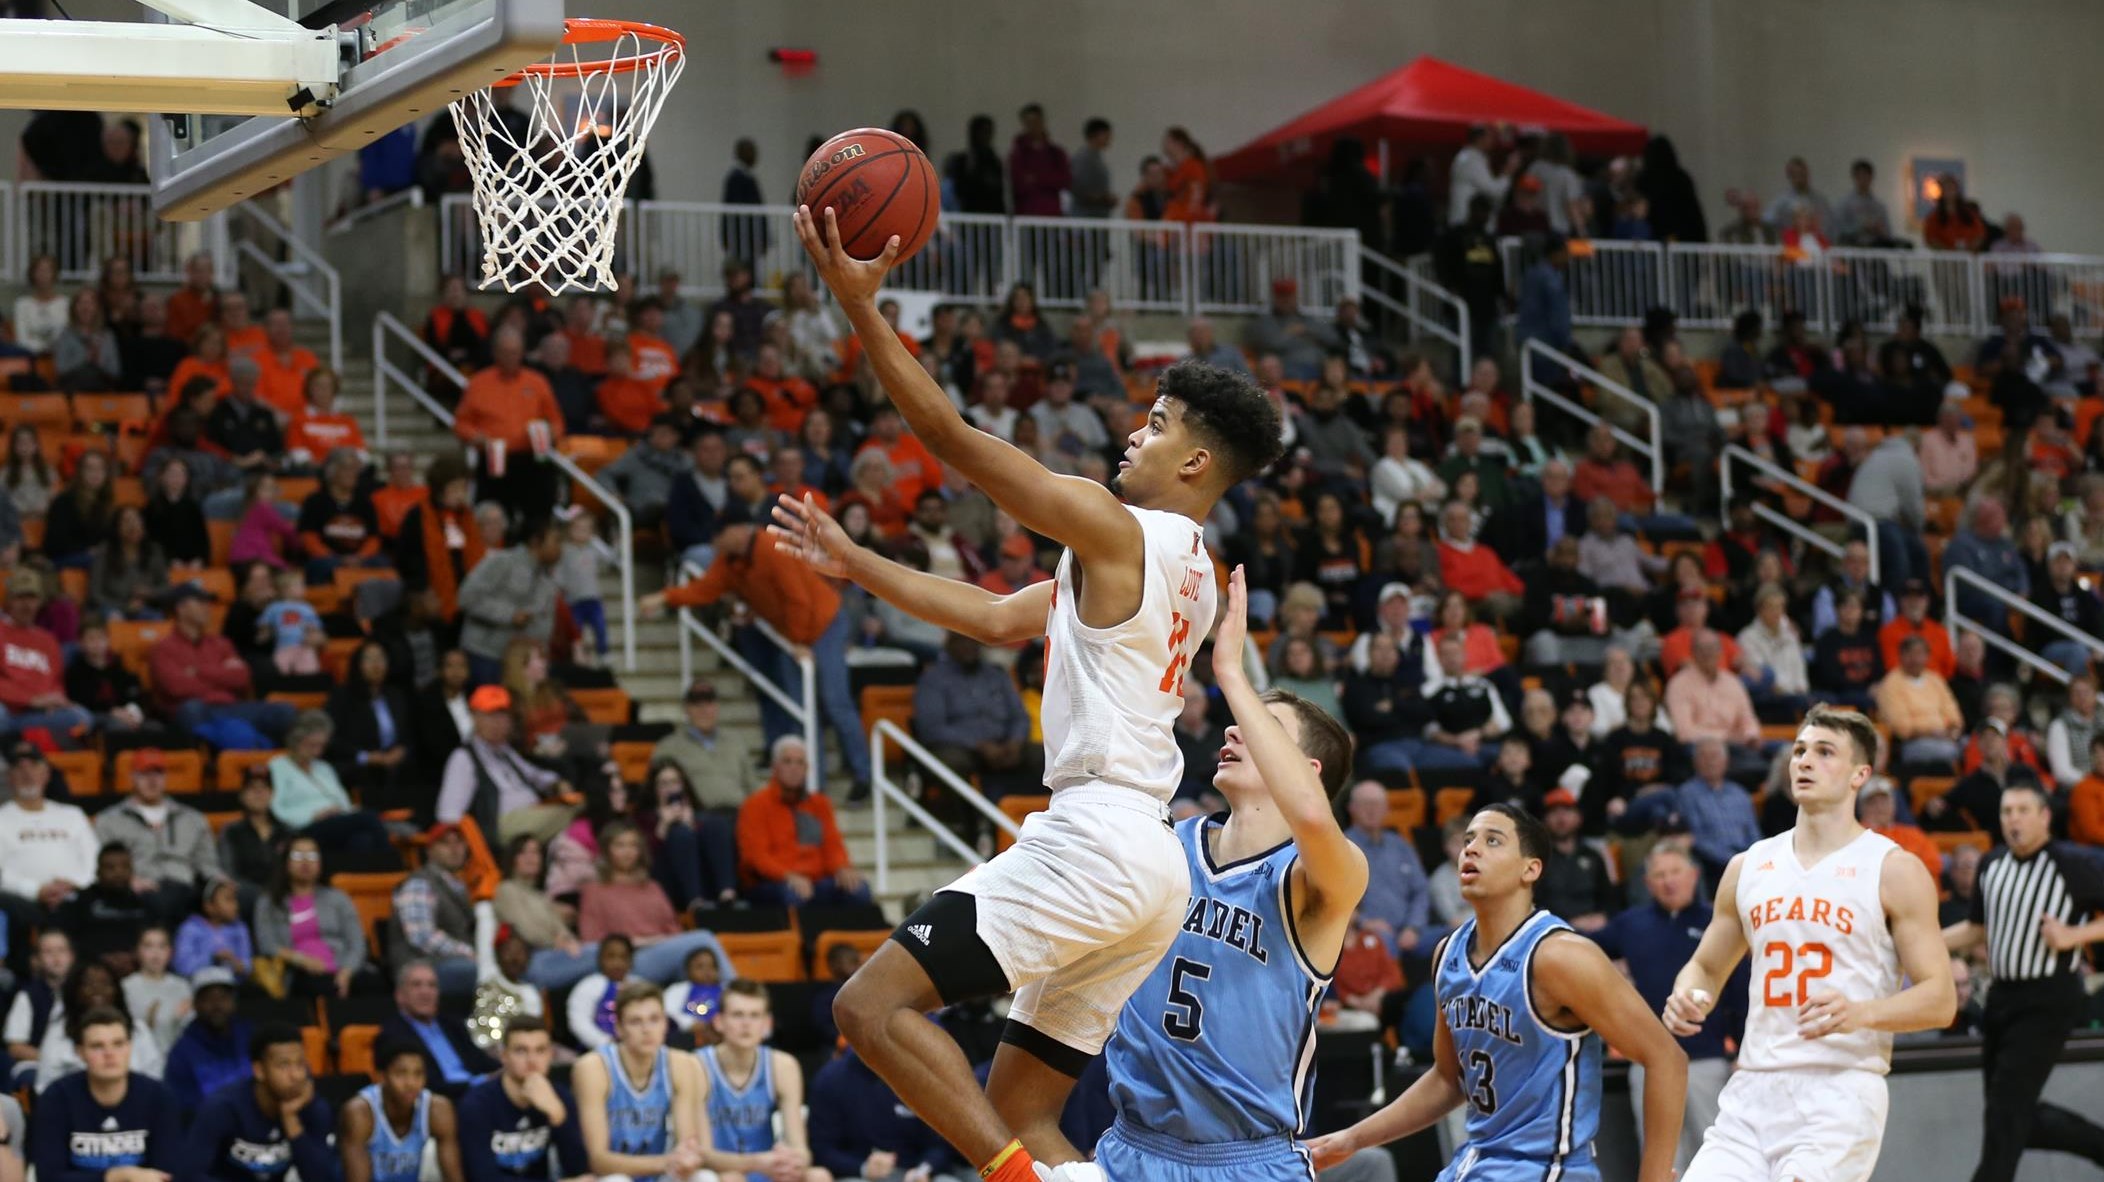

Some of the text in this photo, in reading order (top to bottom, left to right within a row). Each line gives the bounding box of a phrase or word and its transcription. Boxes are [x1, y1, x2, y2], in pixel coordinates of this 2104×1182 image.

[1179, 565, 1204, 602] LOVE
[907, 925, 931, 946] adidas
[1182, 896, 1269, 966] ADEL
[1750, 896, 1854, 935] BEARS
[1162, 955, 1213, 1043] 5
[1764, 941, 1833, 1007] 22
[1440, 994, 1523, 1046] TADEL
